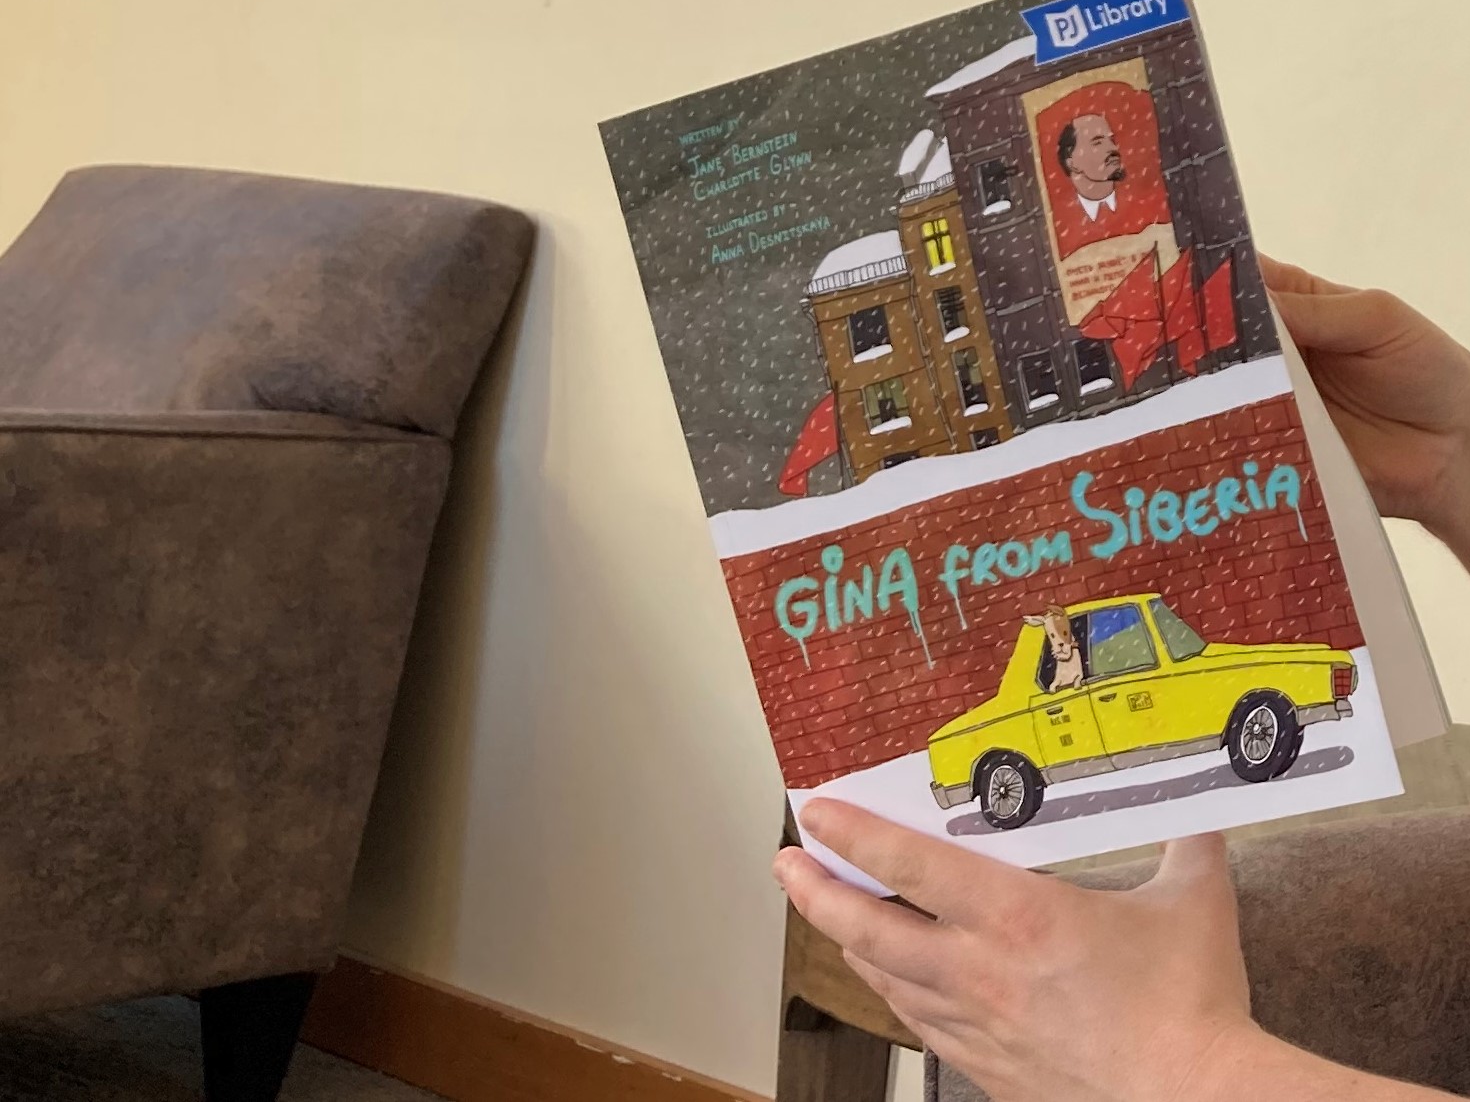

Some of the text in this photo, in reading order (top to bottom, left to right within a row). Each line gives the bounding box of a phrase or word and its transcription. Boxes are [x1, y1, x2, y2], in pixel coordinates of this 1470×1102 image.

[1054, 13, 1081, 42] PJ
[678, 117, 740, 146] WRITTEN BY
[731, 131, 799, 166] BERNSTEIN
[693, 151, 813, 202] CHARLOTTE GLYNN
[705, 203, 786, 239] ILLUSTRATED BY
[711, 216, 831, 264] ANNA DESNITSKAYA
